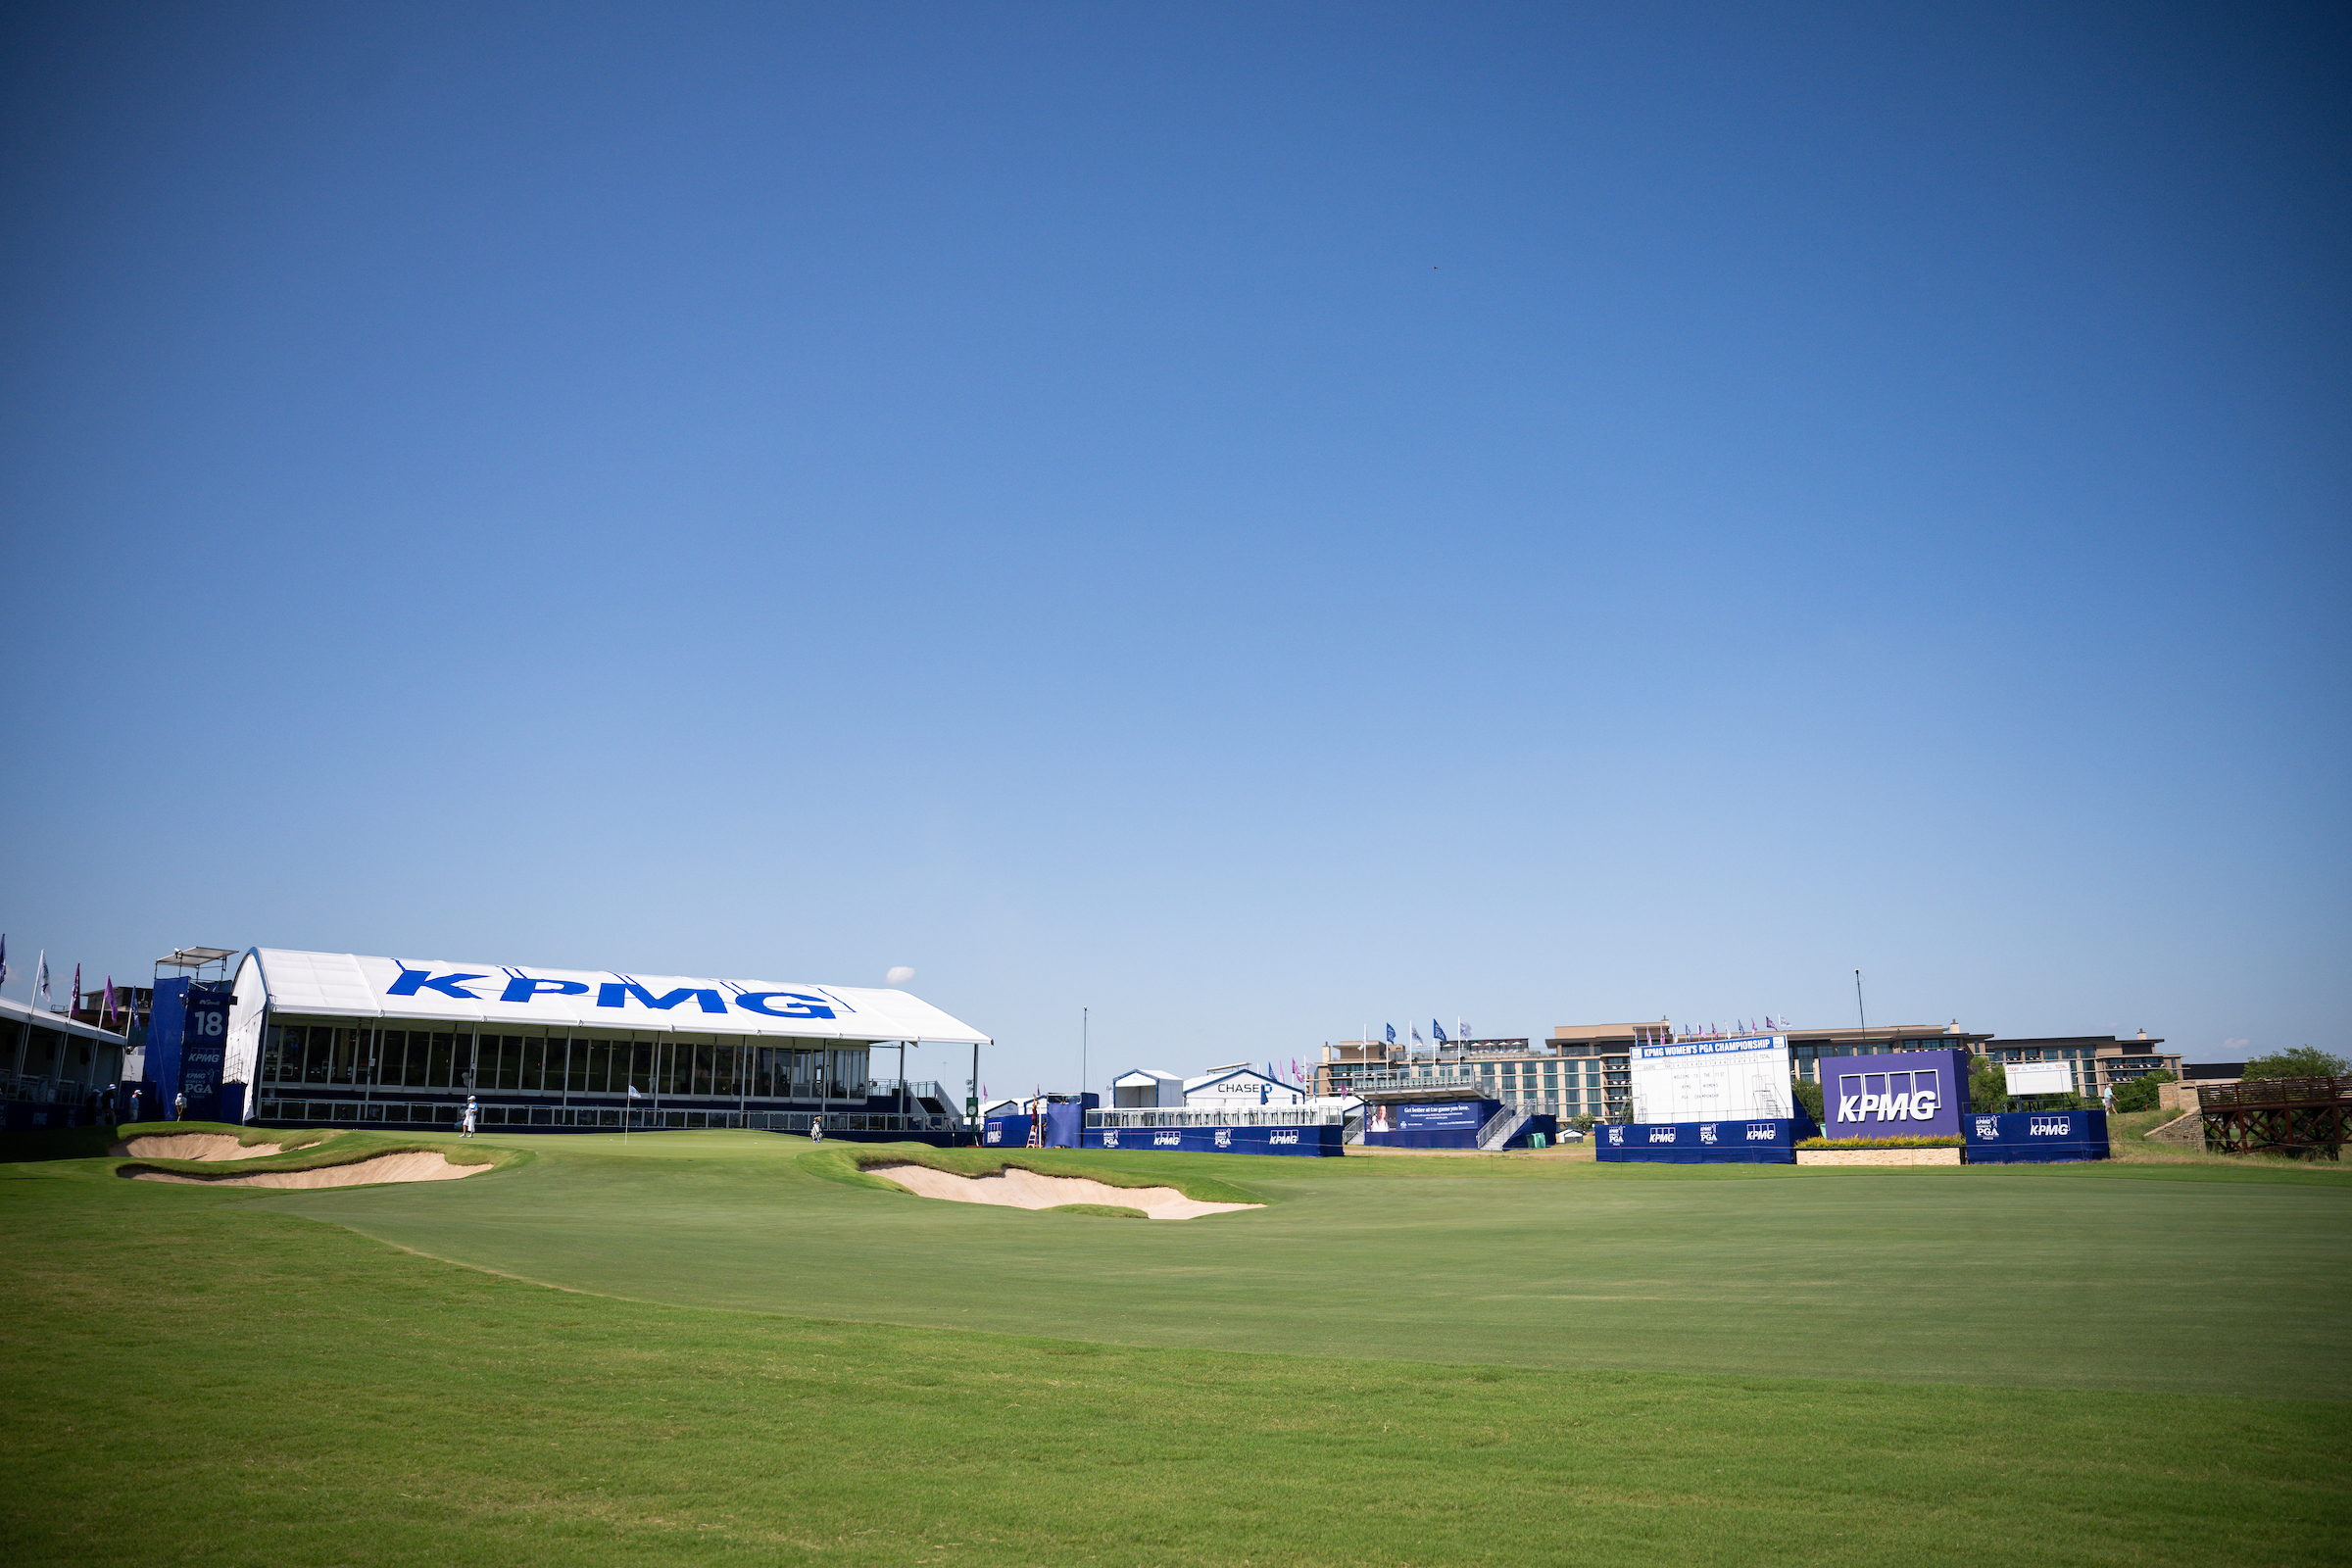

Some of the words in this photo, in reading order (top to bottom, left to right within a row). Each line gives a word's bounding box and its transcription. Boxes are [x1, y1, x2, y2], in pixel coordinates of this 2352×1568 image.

[386, 969, 837, 1019] KPMG
[194, 1011, 223, 1037] 18
[1643, 1047, 1664, 1057] KPMG
[1664, 1045, 1697, 1055] WOMEN'S
[1698, 1043, 1714, 1054] PGA
[1714, 1039, 1771, 1053] CHAMPIONSHIP
[188, 1053, 220, 1063] KPMG
[183, 1083, 213, 1094] PGA
[1217, 1084, 1259, 1093] CHASE
[1837, 1090, 1936, 1123] KPMG
[2030, 1123, 2069, 1136] KPMG
[1152, 1136, 1180, 1146] KPMG
[1269, 1135, 1298, 1145] KPMG
[1648, 1133, 1675, 1144] KPMG
[1746, 1130, 1775, 1141] KPMG
